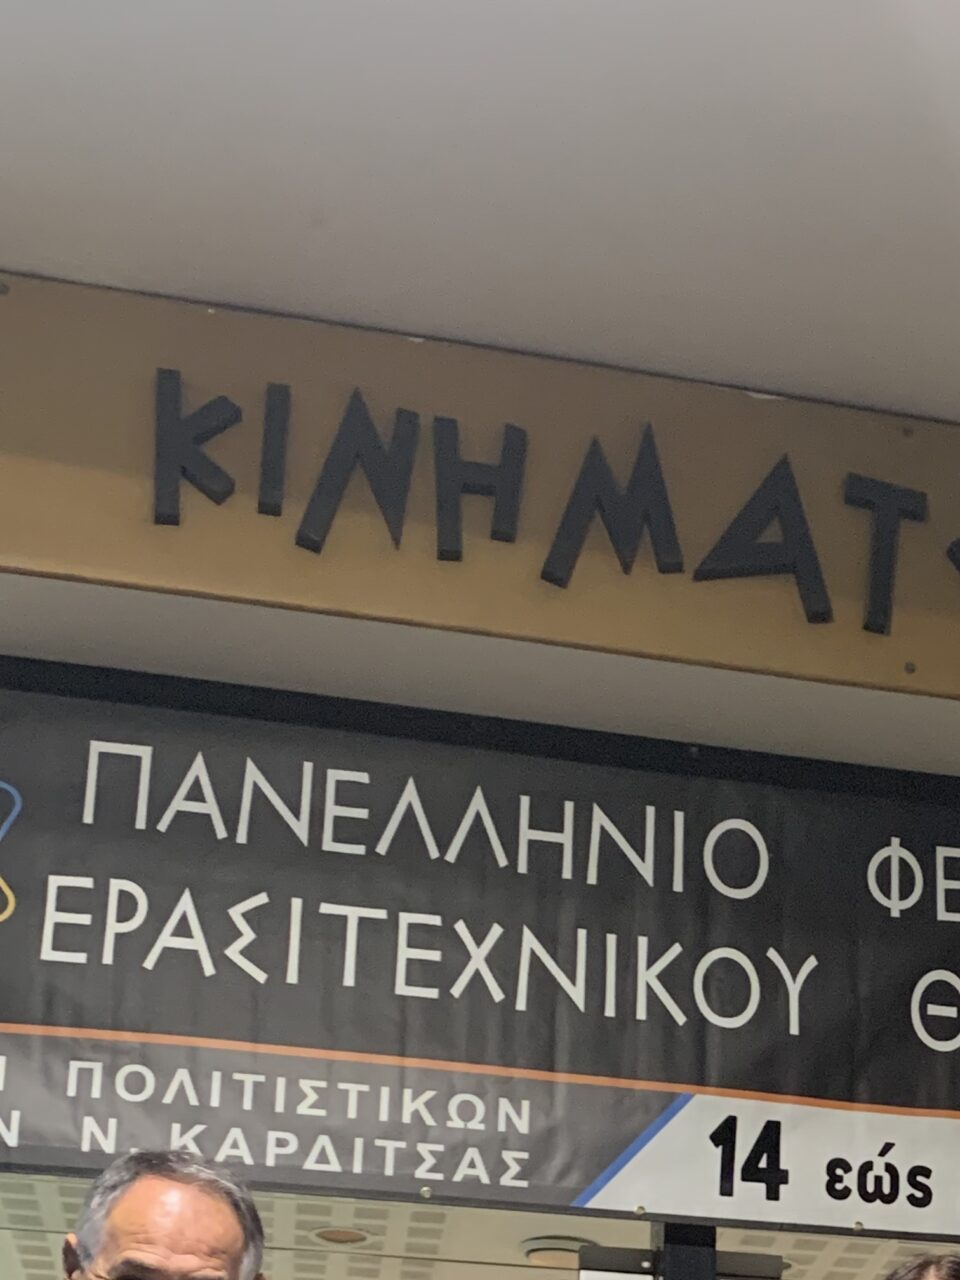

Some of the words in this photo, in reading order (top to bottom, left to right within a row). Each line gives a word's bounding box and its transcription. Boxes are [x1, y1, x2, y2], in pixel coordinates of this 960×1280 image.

[82, 740, 770, 900] ΠΑΝΕΛΛΗΝΙΟ
[39, 874, 818, 1035] ΕΡΑΣΙΤΕΧΝΙΚΟΥ
[66, 1060, 532, 1136] ΠΟΛΙΤΙΣΤΙΚΩΝ
[169, 1122, 531, 1188] ΚΑΡΔΙΤΣΑΣ
[708, 1115, 789, 1200] 14
